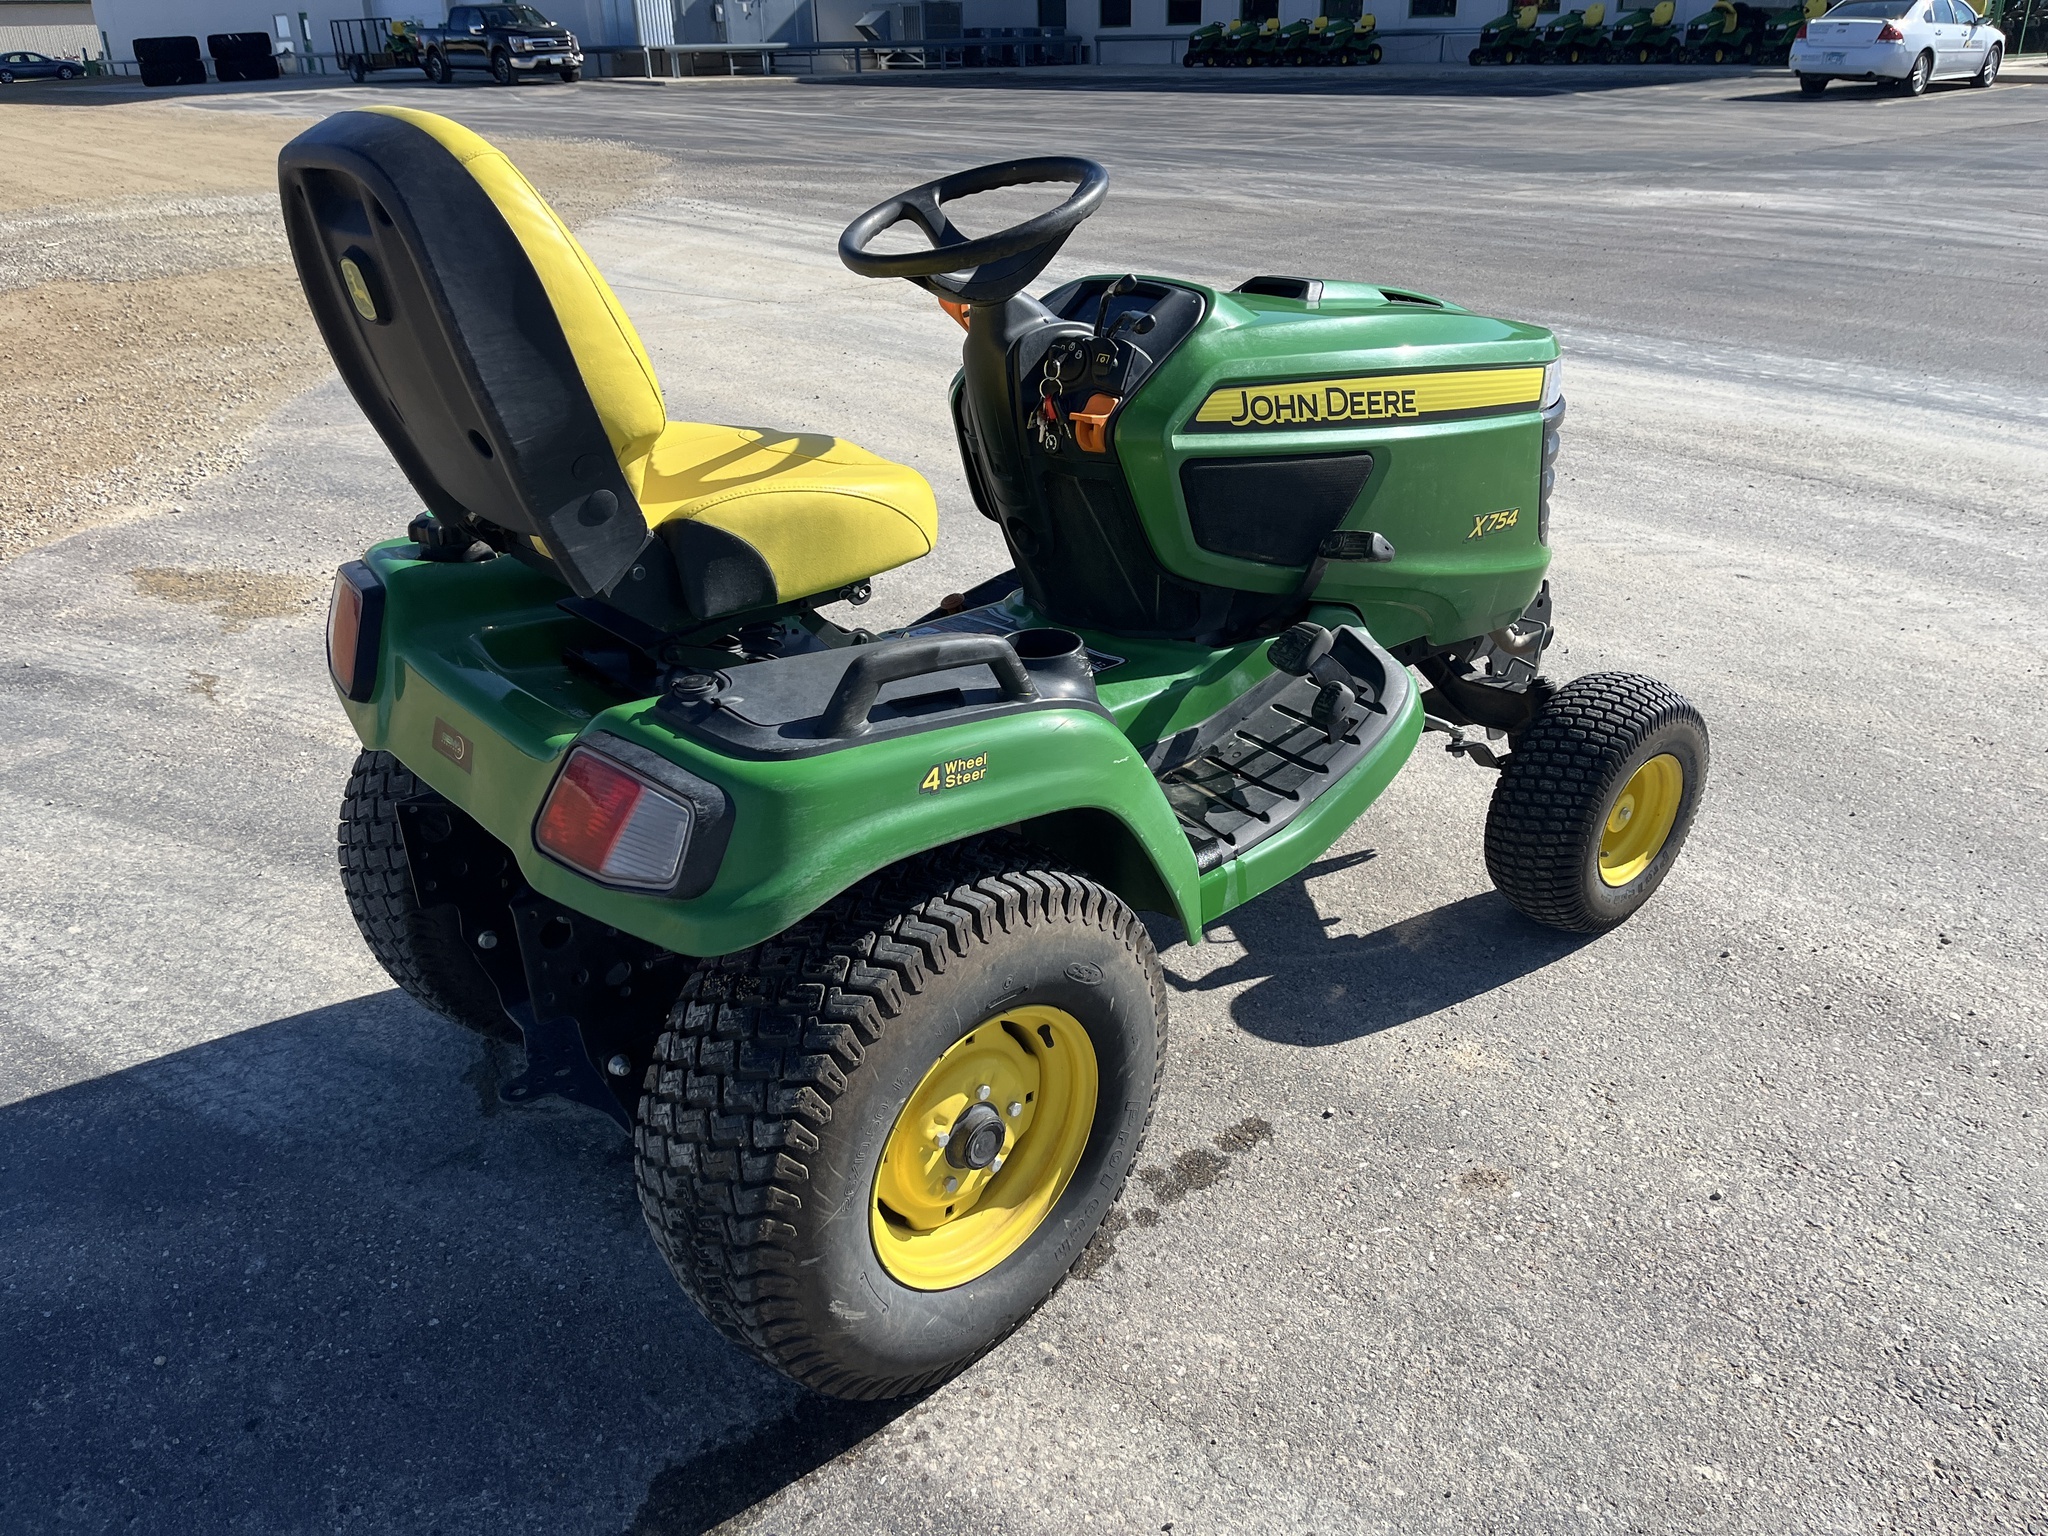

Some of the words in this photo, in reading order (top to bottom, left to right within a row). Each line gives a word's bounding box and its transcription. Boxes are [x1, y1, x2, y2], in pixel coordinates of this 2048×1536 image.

[1231, 390, 1319, 423] JOHN
[1325, 386, 1417, 419] DEERE
[1466, 506, 1520, 540] X754
[921, 766, 941, 791] 4
[944, 752, 988, 775] Wheel
[944, 767, 987, 789] Steer
[1065, 962, 1103, 984] CST
